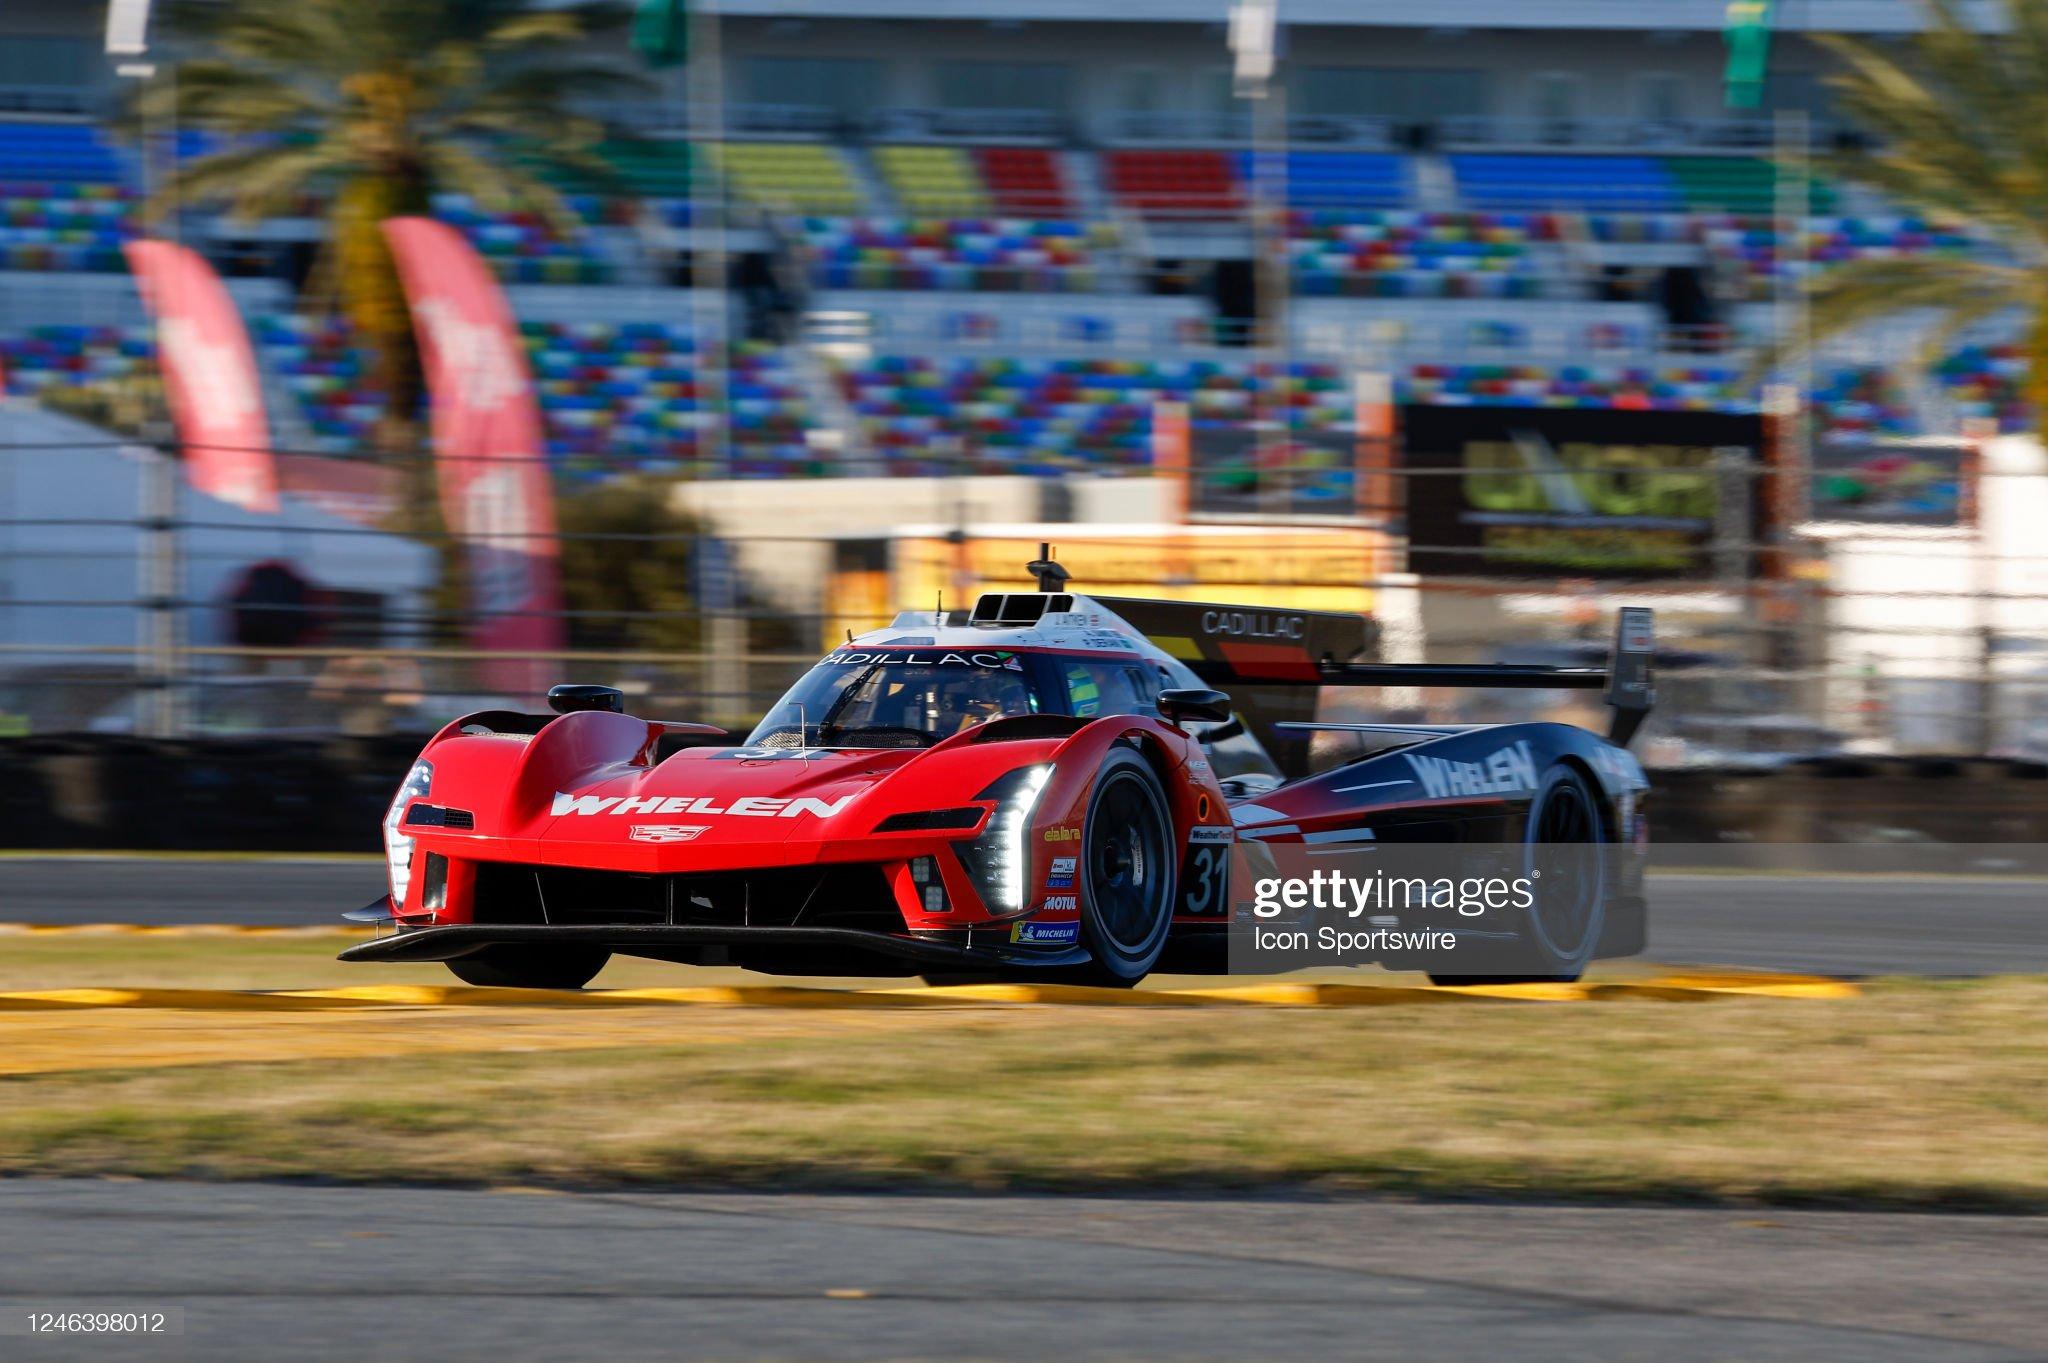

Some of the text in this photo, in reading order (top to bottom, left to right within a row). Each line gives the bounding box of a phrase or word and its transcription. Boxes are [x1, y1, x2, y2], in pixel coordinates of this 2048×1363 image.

[1201, 610, 1304, 639] CADILLAC
[1405, 740, 1539, 798] WHELEN
[550, 791, 858, 818] WHELEN
[1186, 847, 1228, 912] 31
[1043, 896, 1077, 910] MOTUL
[1036, 928, 1075, 938] MICHELIN
